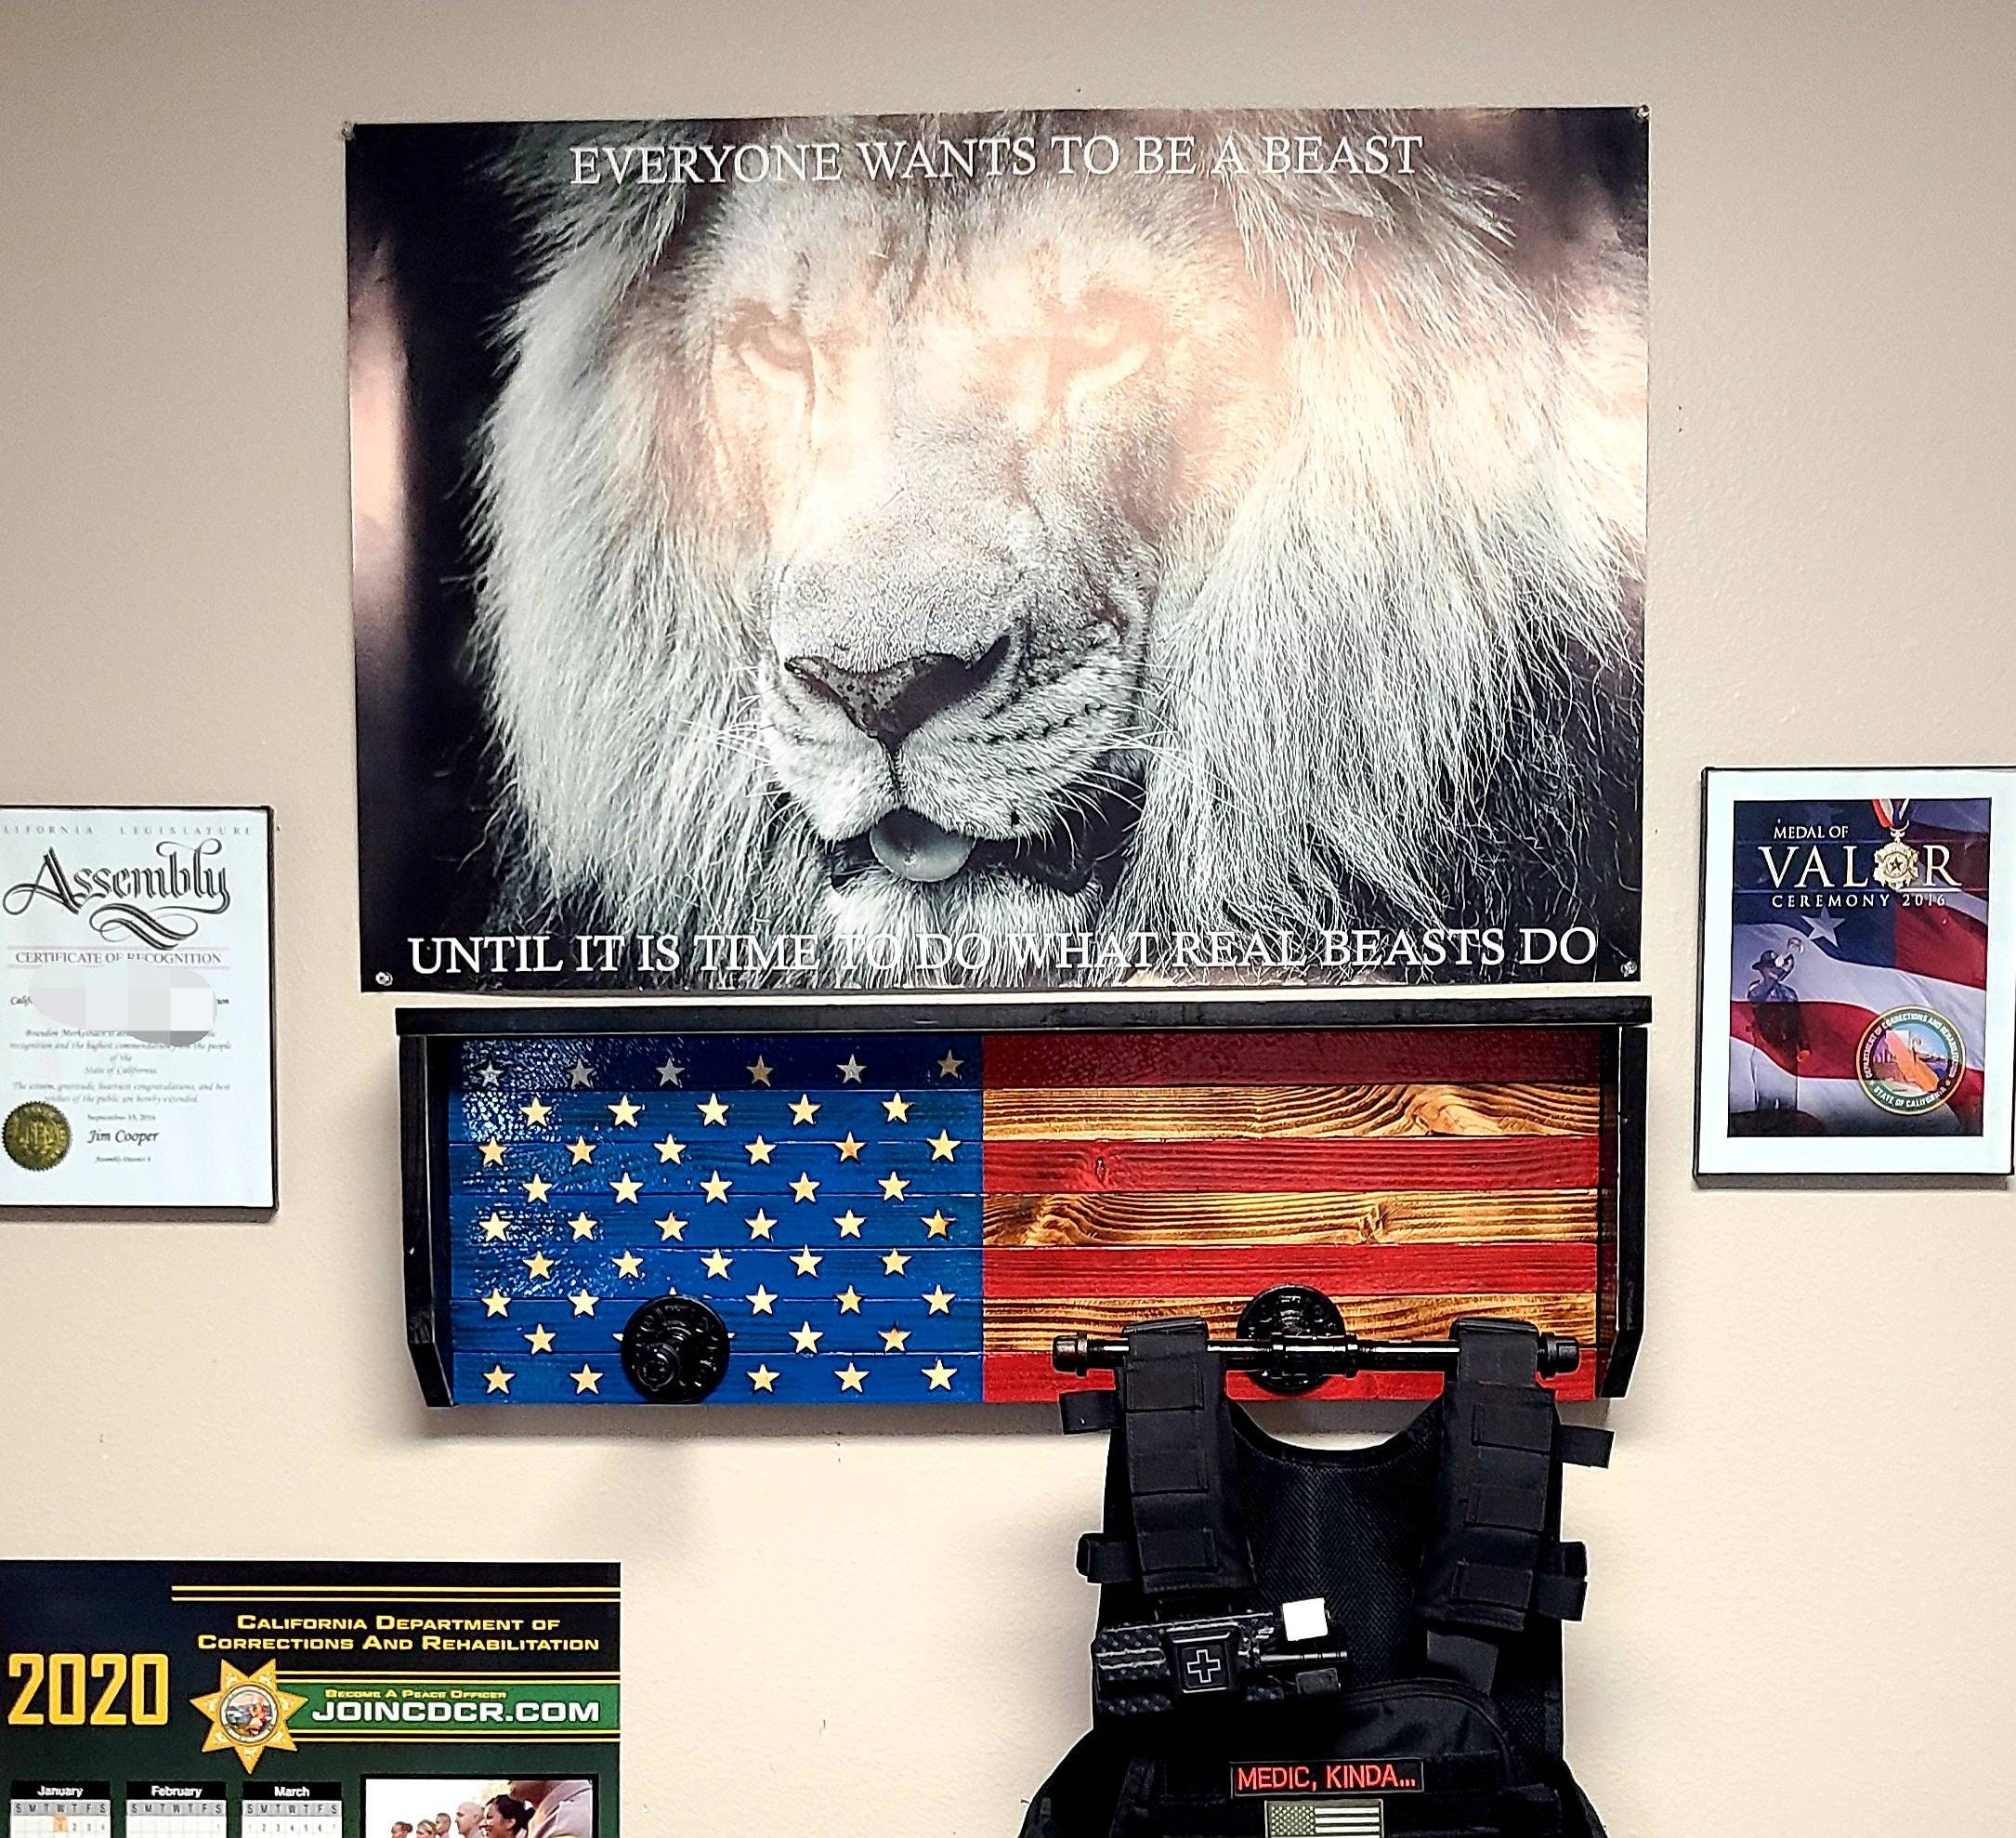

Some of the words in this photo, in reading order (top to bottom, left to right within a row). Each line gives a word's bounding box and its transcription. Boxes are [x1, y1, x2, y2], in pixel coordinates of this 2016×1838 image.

[569, 144, 842, 184] EVERYONE
[856, 137, 1036, 181] WANTS
[1051, 136, 1119, 175] TO
[1133, 136, 1197, 175] BE
[1211, 135, 1247, 175] A
[1263, 135, 1424, 175] BEAST
[1774, 826, 1825, 839] MEDAL
[1828, 825, 1849, 838] OF
[3, 838, 230, 918] Assembly
[1772, 894, 1890, 908] CEREMONY
[1902, 894, 1945, 907] 2016
[16, 952, 102, 965] CERTIFICATE
[407, 935, 563, 975] UNTIL
[575, 935, 628, 973] IT
[636, 935, 680, 973] IS
[694, 935, 818, 973] TIME
[827, 933, 901, 972] TO
[915, 932, 991, 971] DO
[1007, 929, 1159, 968] WHAT
[1172, 929, 1310, 967] REAL
[1320, 928, 1506, 966] BEASTS
[1518, 926, 1597, 965] DO
[1927, 1017, 1943, 1030] AND
[1873, 1085, 1894, 1104] STATE
[1894, 1099, 1905, 1109] OF
[1905, 1086, 1948, 1109] CALIFORNIA
[86, 1129, 111, 1144] Jim
[114, 1129, 160, 1147] Cooper
[237, 1614, 368, 1631] CALIFORNIA
[376, 1615, 524, 1632] DEPARTMENT
[531, 1619, 561, 1632] OF
[197, 1635, 354, 1650] CORRECTIONS
[362, 1635, 413, 1651] AND
[421, 1635, 600, 1651] REHABILITATION
[7, 1652, 170, 1726] 2020
[325, 1688, 382, 1699] BECOME
[386, 1688, 399, 1699] A
[402, 1688, 447, 1699] PEACE
[452, 1688, 507, 1700] OFFICER
[311, 1700, 601, 1724] JOINCDCR.COM
[1237, 1766, 1317, 1792] MEDIC,
[1325, 1764, 1417, 1789] KINDA...
[37, 1785, 84, 1799] January
[151, 1785, 203, 1799] February
[274, 1786, 310, 1798] March
